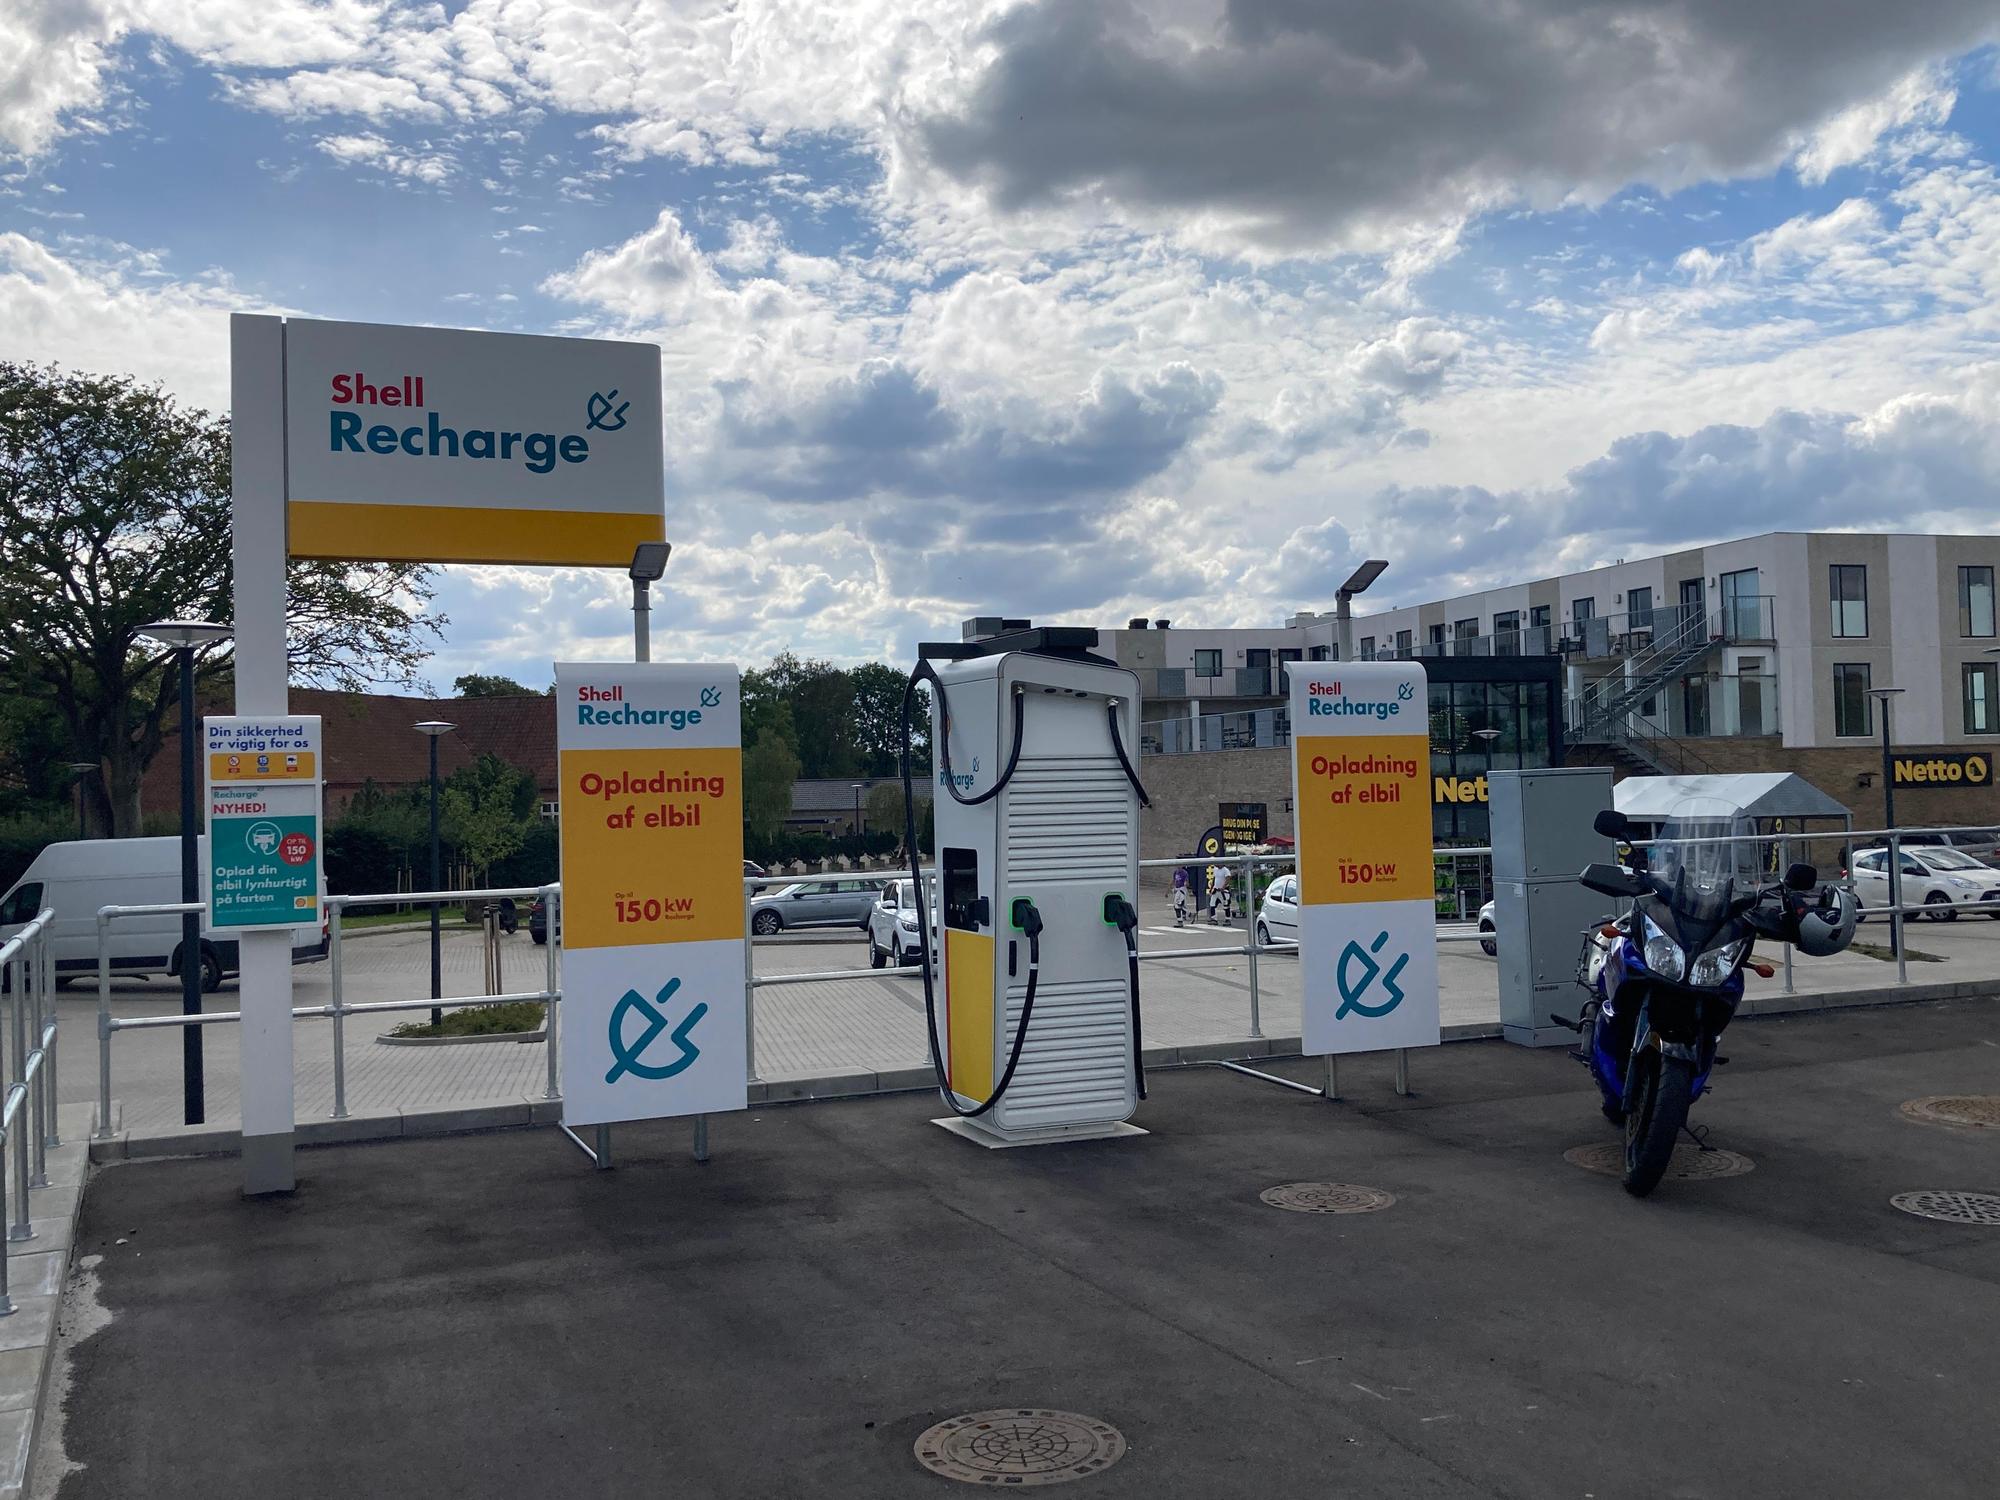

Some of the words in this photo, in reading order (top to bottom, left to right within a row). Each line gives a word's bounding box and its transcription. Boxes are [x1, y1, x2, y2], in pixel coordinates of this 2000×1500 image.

[331, 373, 424, 408] Shell
[330, 411, 590, 474] Recharge
[578, 686, 623, 702] Shell
[1309, 682, 1341, 695] Shell
[578, 703, 702, 730] Recharge
[1309, 696, 1399, 720] Recharge
[209, 726, 231, 737] Din
[236, 725, 303, 737] sikkerhed
[209, 740, 223, 749] er
[228, 738, 266, 752] vigtig
[270, 737, 290, 748] for
[294, 740, 309, 748] os
[1311, 755, 1417, 779] Opladning
[1894, 760, 1962, 782] Netto
[580, 770, 725, 800] Opladning
[940, 770, 974, 790] Rharge
[1435, 776, 1489, 803] Net
[213, 790, 258, 800] Recharge
[1331, 783, 1353, 804] af
[1358, 783, 1400, 803] elbil
[213, 803, 266, 814] NYHED!
[606, 804, 636, 829] af
[644, 803, 701, 829] elbil
[286, 845, 307, 855] 150
[216, 865, 255, 879] Oplad
[257, 864, 277, 875] din
[1338, 863, 1373, 884] 150
[1375, 863, 1396, 876] kW
[216, 879, 242, 891] elbil
[245, 877, 307, 892] lynhurtigt
[216, 893, 232, 907] på
[236, 892, 274, 903] farten
[615, 899, 661, 923] 150
[665, 898, 693, 912] kW
